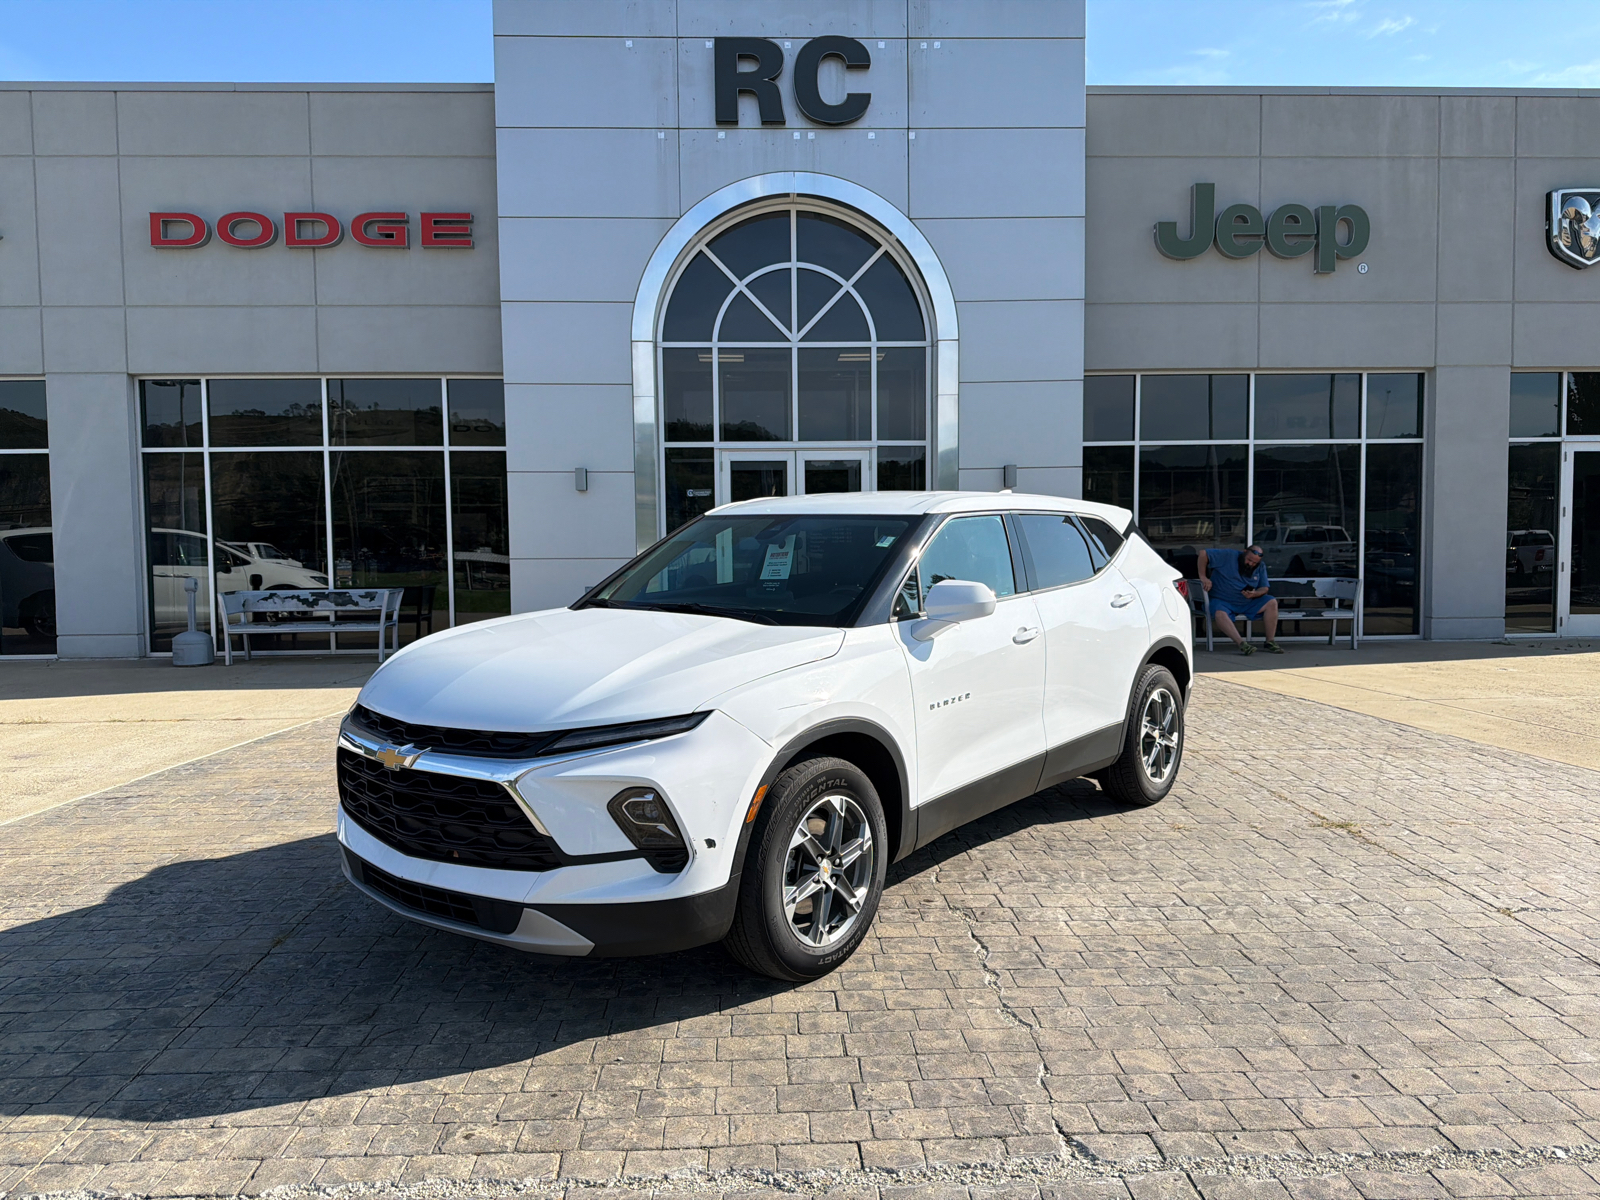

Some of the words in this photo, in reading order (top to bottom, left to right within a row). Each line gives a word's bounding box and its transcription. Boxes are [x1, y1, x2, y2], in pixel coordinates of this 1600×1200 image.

[714, 35, 871, 126] RC
[149, 211, 474, 249] DODGE
[1153, 182, 1371, 275] Jeep
[929, 692, 971, 711] BLAZER
